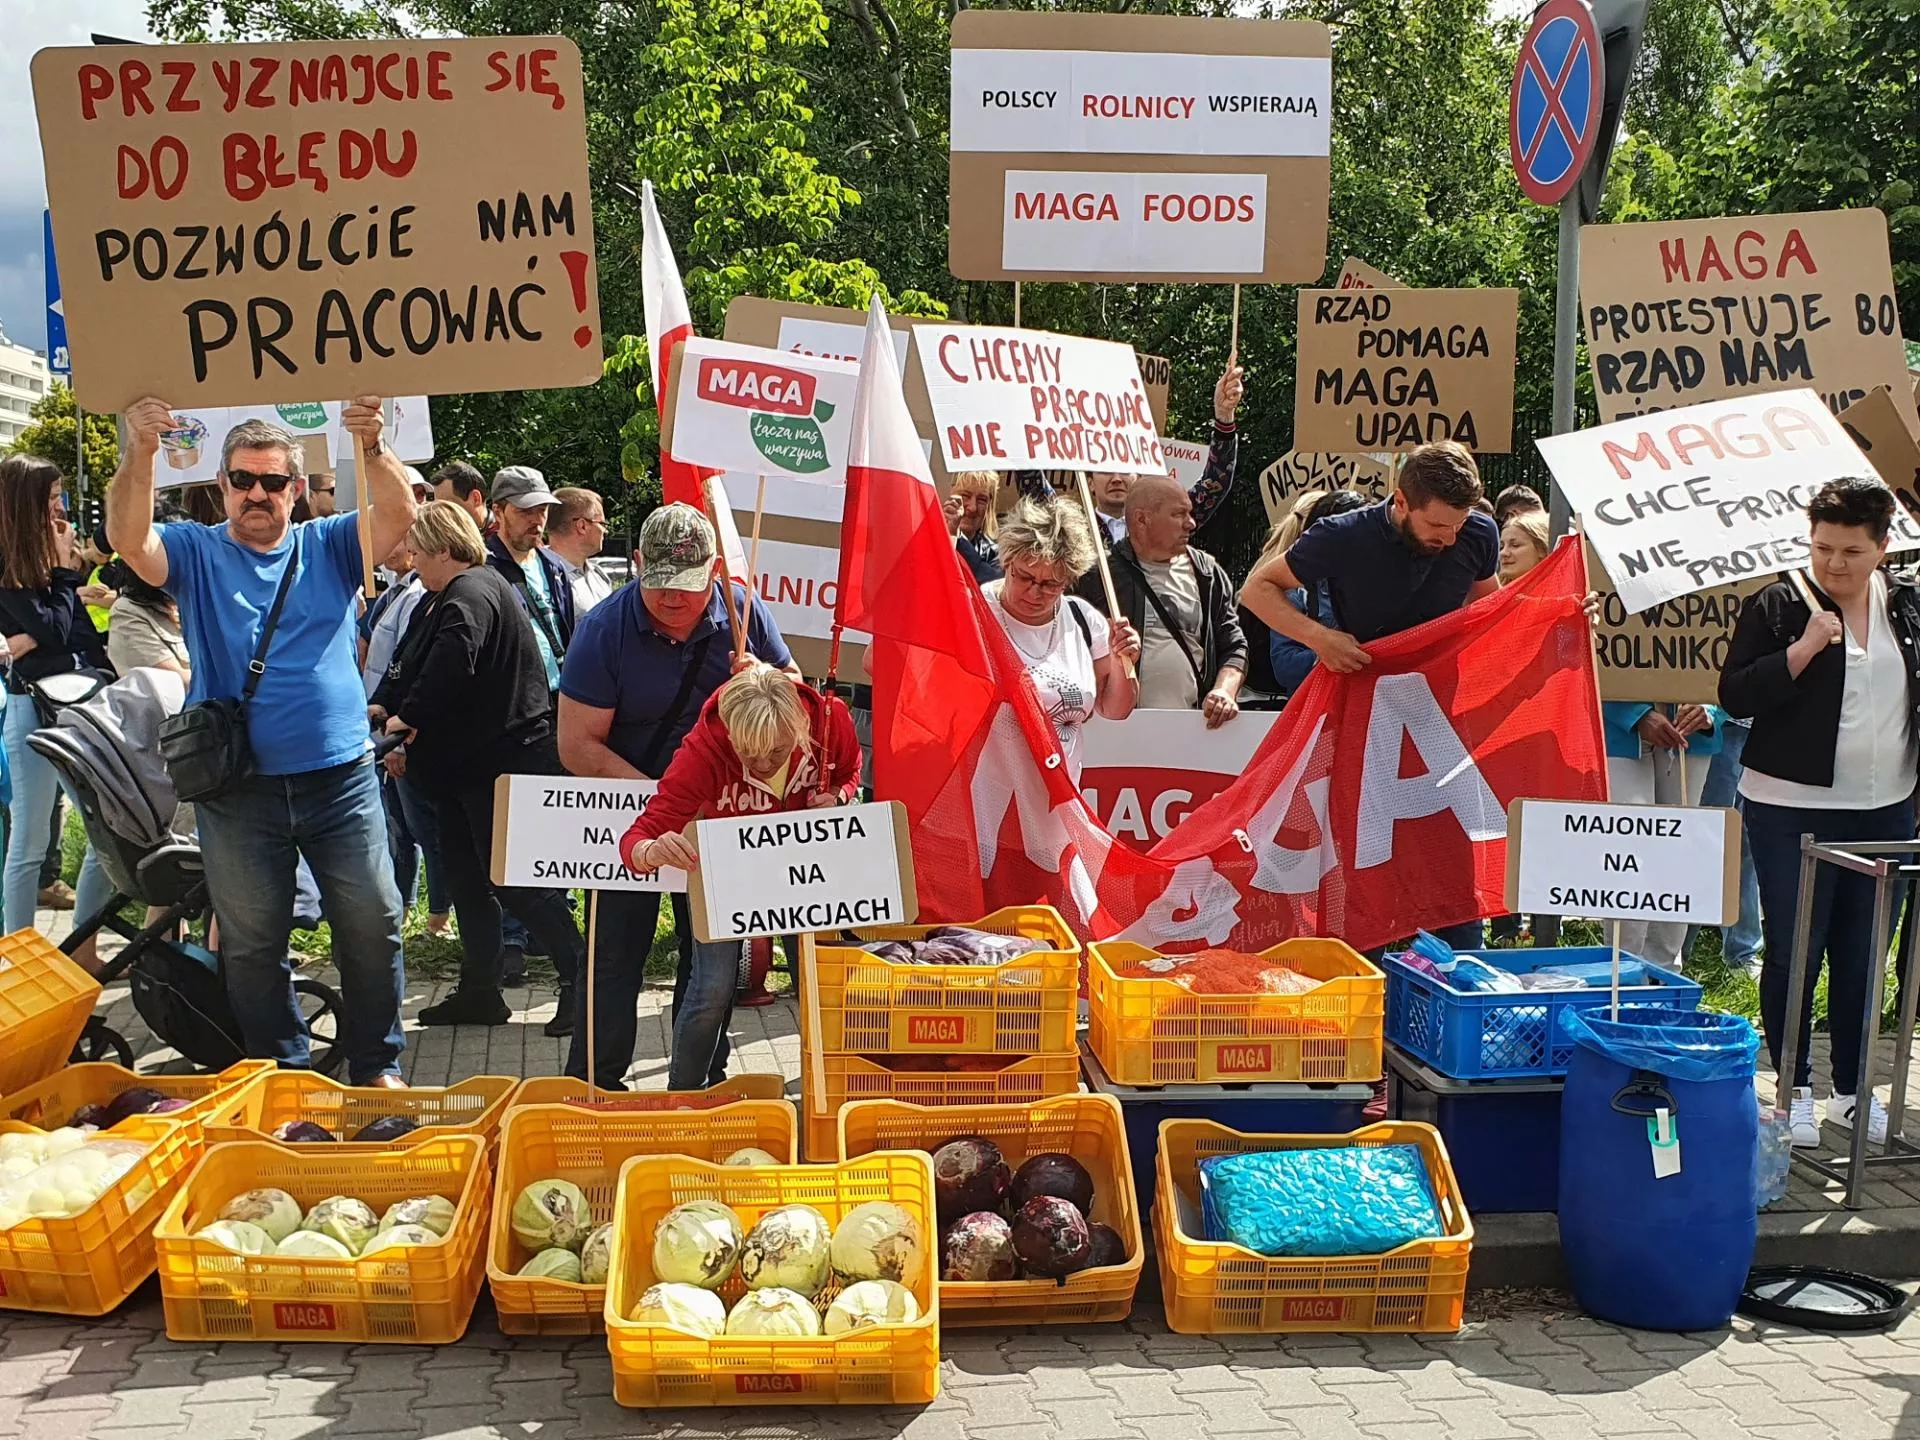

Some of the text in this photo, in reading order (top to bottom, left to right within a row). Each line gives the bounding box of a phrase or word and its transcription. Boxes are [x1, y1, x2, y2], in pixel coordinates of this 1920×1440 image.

[78, 49, 565, 119] PRZYZNAJCIE SIĘ
[982, 90, 1318, 119] POLSCY ROLNICY WSPIERAJĄ
[117, 128, 417, 201] DO BŁĘDU
[1014, 192, 1254, 223] MAGA FOODS
[95, 192, 574, 281] POZWÓLCIE NAM
[1659, 229, 1817, 283] MAGA
[1315, 295, 1391, 327] RZĄD
[1590, 294, 1894, 342] PROTESTUJE BO
[1358, 325, 1489, 357] POMAGA
[939, 335, 1060, 383] CHCEMY
[1597, 338, 1815, 394] RZĄD NAM
[709, 368, 803, 406] MAGA
[1315, 367, 1438, 406] MAGA
[1030, 379, 1151, 430] PRACOWAĆ
[947, 422, 1161, 465] NIE PROTESTOWAĆ
[1357, 411, 1478, 449] UPADA
[1602, 407, 1830, 480] MAGA
[765, 444, 823, 465] warzywa
[1161, 443, 1200, 461] ÓWKA
[1595, 476, 1719, 525] CHCE
[1619, 540, 1690, 577] NIE
[1639, 592, 1751, 628] WSPAR
[1596, 631, 1731, 671] ROLNIKÓ
[543, 790, 651, 810] ZIEMNIAK
[583, 827, 614, 845] NA
[738, 815, 866, 850] KAPUSTA
[1564, 814, 1682, 837] MAJONEZ
[788, 863, 825, 885] NA
[1603, 853, 1639, 873] NA
[731, 898, 891, 935] SANKCJACH
[1549, 886, 1690, 913] SANKCJACH
[915, 1020, 957, 1040] MAGA
[1224, 1047, 1265, 1069] MAGA
[281, 1307, 328, 1327] MAGA
[1290, 1300, 1335, 1317] MAGA
[744, 1375, 795, 1391] MAGA
